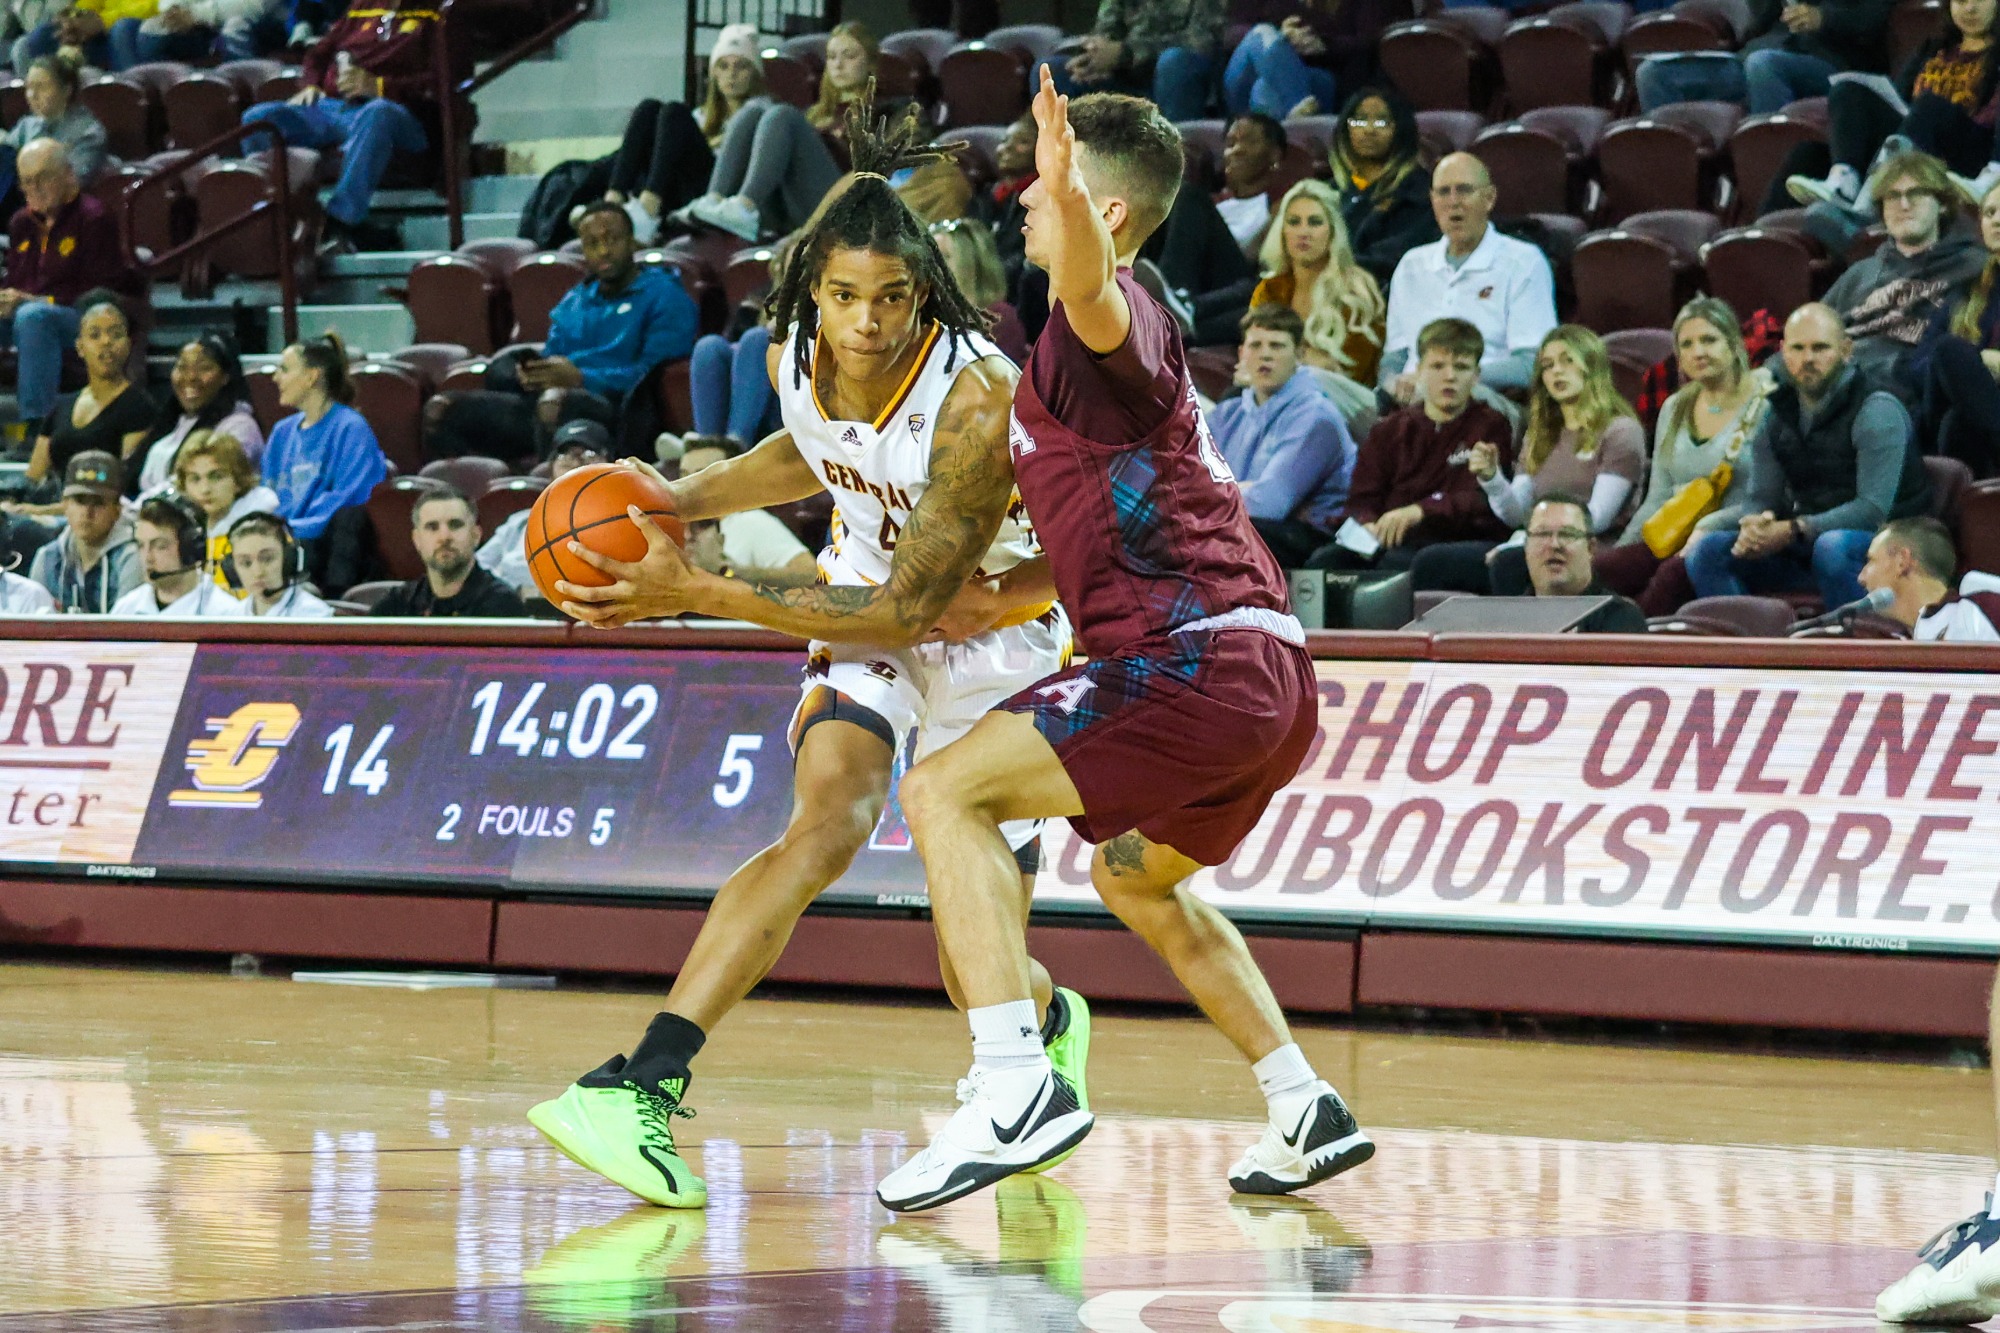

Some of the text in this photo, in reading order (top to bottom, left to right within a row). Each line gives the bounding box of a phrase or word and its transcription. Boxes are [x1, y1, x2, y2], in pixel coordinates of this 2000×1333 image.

[821, 458, 914, 512] CENRAL
[0, 663, 135, 748] RE
[1033, 674, 1099, 716] A
[468, 680, 660, 760] 14:02
[1580, 686, 2000, 801] ONLINE
[320, 722, 396, 796] 14
[712, 733, 764, 809] 5
[7, 784, 102, 828] ter
[435, 802, 616, 846] 2 FOULS 5
[86, 865, 157, 878] DAKTRONICS
[876, 893, 931, 908] DAKTRO
[1812, 935, 1909, 950] DAKTRONICS
